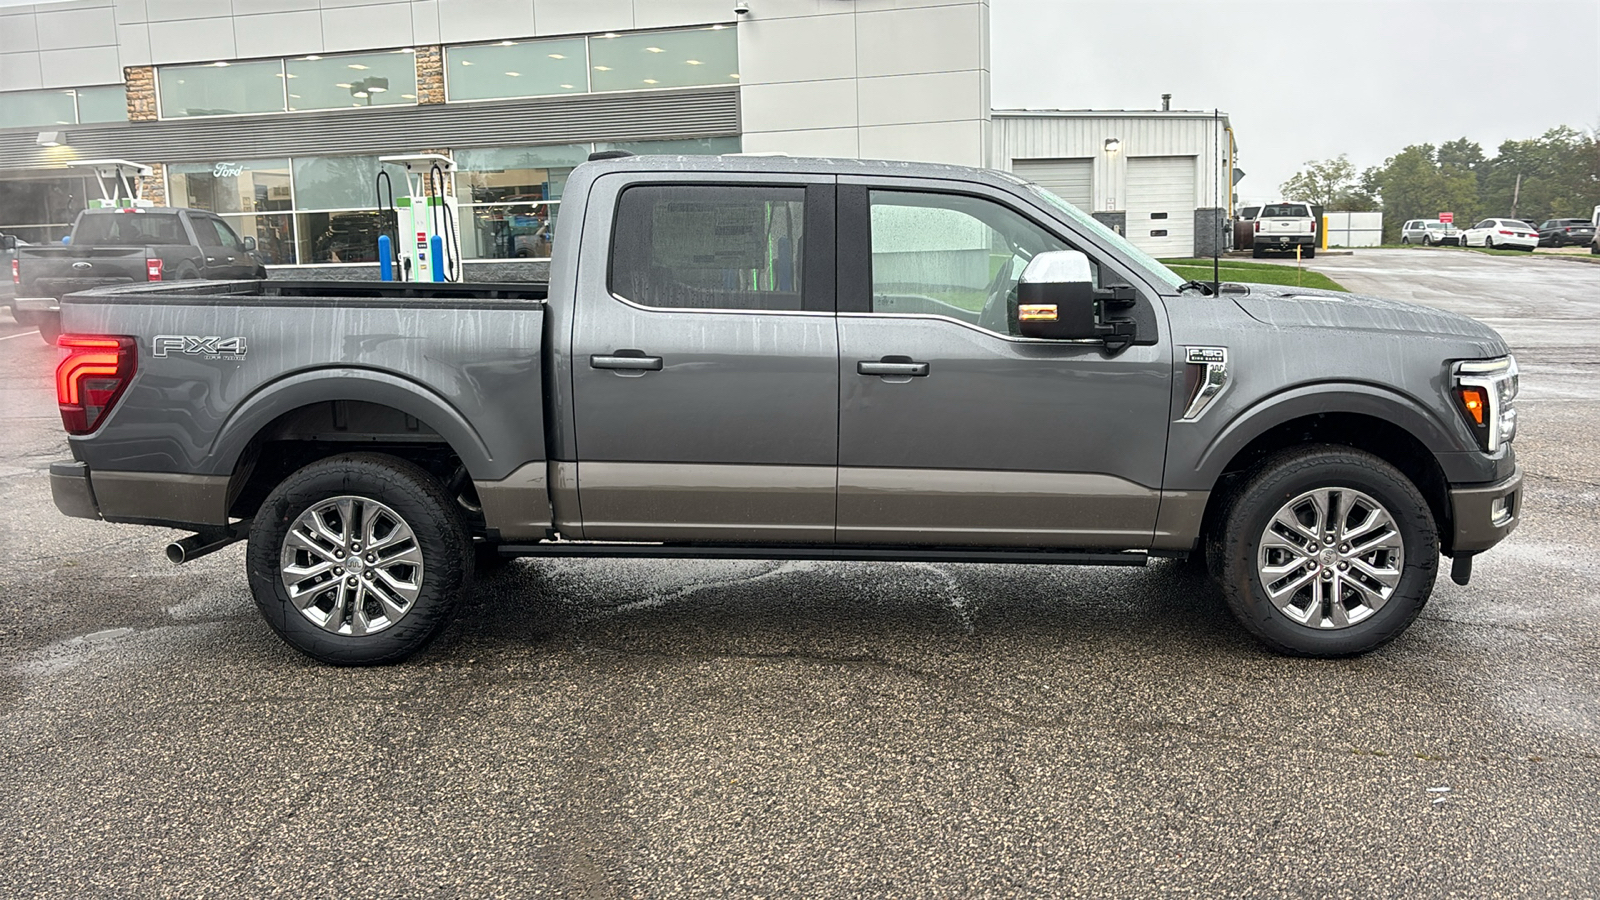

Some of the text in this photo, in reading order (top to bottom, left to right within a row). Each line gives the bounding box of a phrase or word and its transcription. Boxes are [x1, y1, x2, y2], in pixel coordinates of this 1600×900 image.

[213, 162, 243, 177] Ford
[152, 334, 247, 358] FX4
[1190, 349, 1223, 357] F-150
